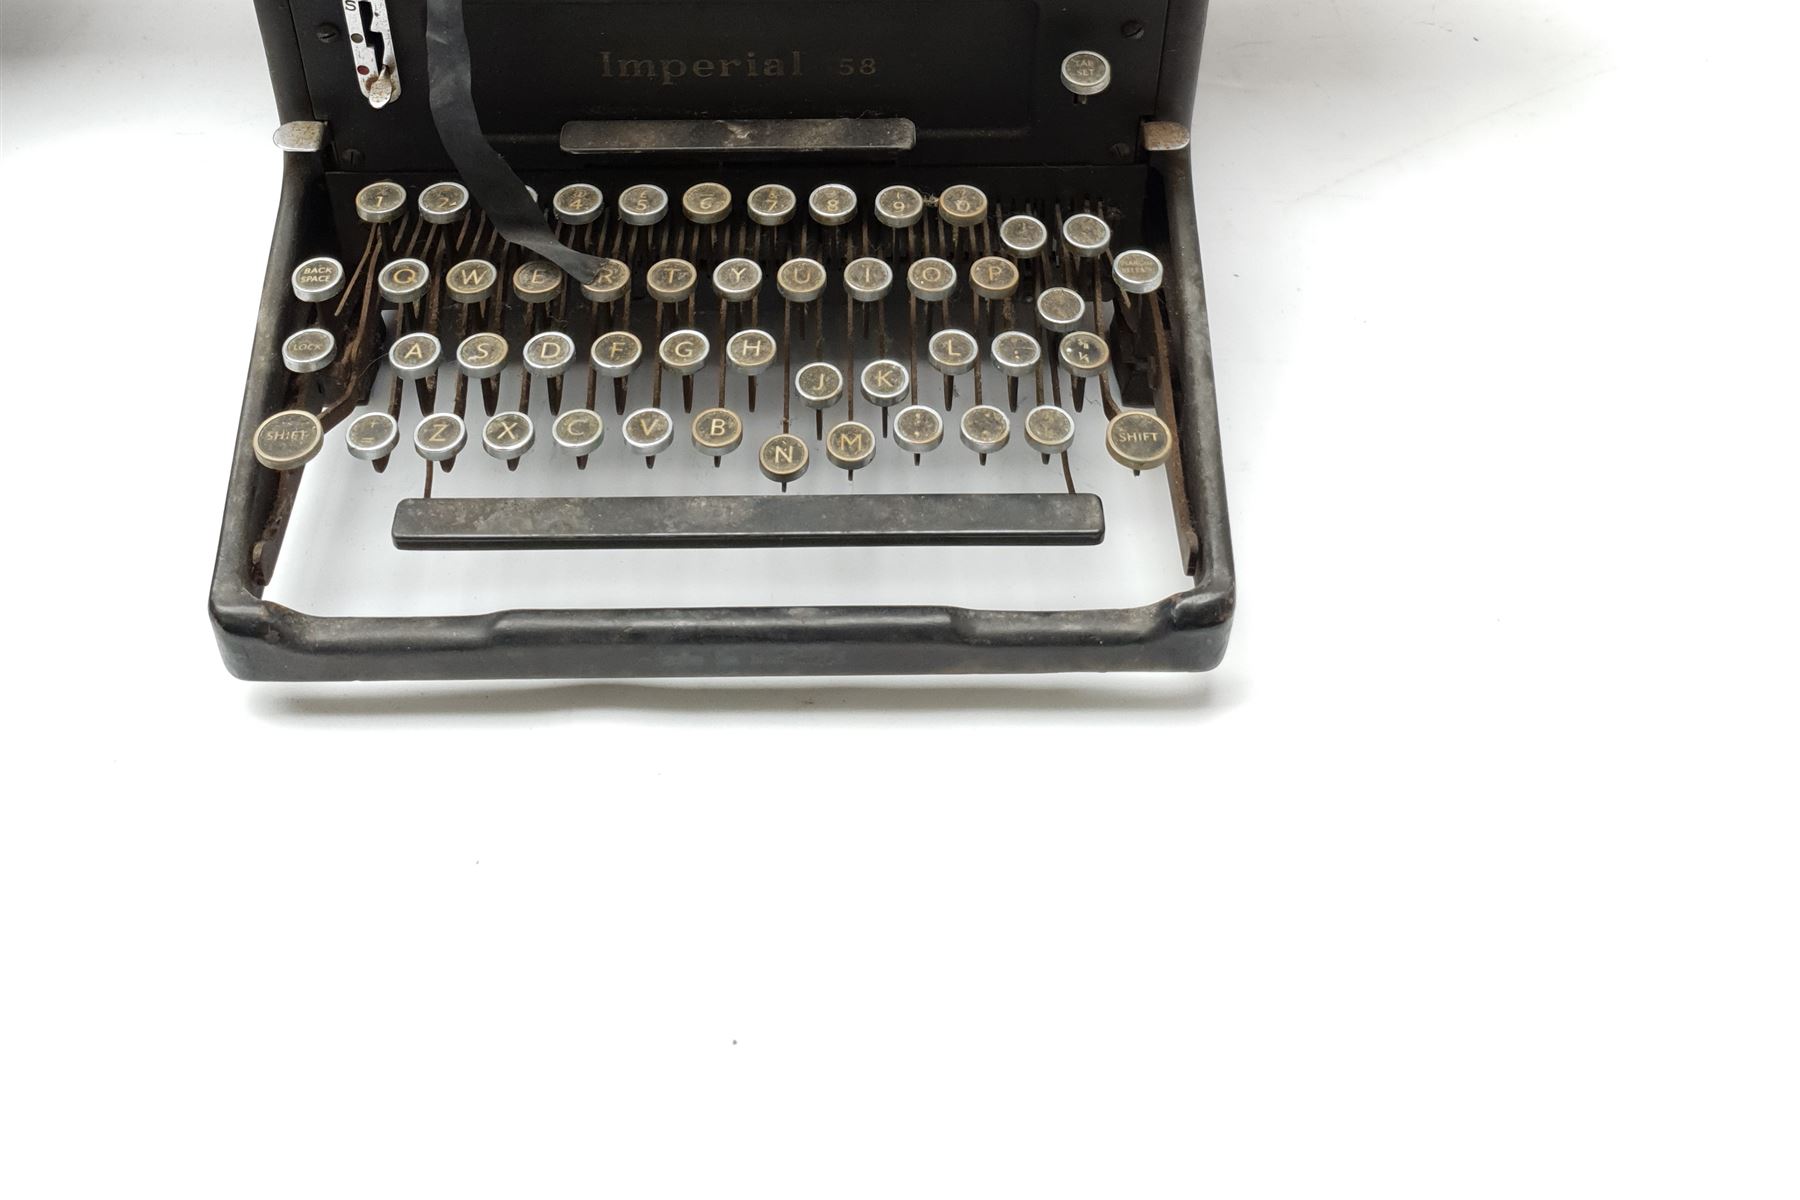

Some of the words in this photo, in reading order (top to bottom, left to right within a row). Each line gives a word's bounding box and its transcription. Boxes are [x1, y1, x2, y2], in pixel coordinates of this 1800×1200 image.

[345, 0, 357, 12] S
[600, 50, 804, 86] Imperial
[838, 57, 877, 76] 58
[568, 199, 583, 210] 4
[635, 199, 648, 211] 5
[699, 198, 713, 210] 6
[766, 199, 778, 212] 7
[826, 199, 840, 211] 8
[892, 201, 906, 213] 9
[299, 274, 331, 283] SPACE
[303, 266, 333, 275] BACK
[392, 268, 417, 285] Q
[460, 268, 488, 286] W
[530, 268, 546, 285] E
[599, 268, 613, 284] R
[664, 267, 681, 284] T
[730, 267, 747, 283] Y
[793, 267, 811, 285] U
[922, 266, 941, 282] O
[988, 266, 1002, 281] P
[403, 342, 423, 360] A
[474, 342, 490, 360] S
[540, 341, 562, 359] D
[609, 341, 626, 359] F
[674, 340, 694, 358] G
[741, 339, 762, 357] H
[947, 338, 961, 356] L
[814, 372, 825, 391] J
[876, 369, 894, 387] K
[266, 428, 310, 442] SHIFT
[428, 423, 449, 442] Z
[496, 421, 519, 441] X
[566, 418, 589, 436] C
[640, 417, 658, 436] V
[709, 417, 726, 437] B
[839, 433, 863, 451] M
[1117, 431, 1160, 443] SHIFT
[774, 445, 794, 464] N
